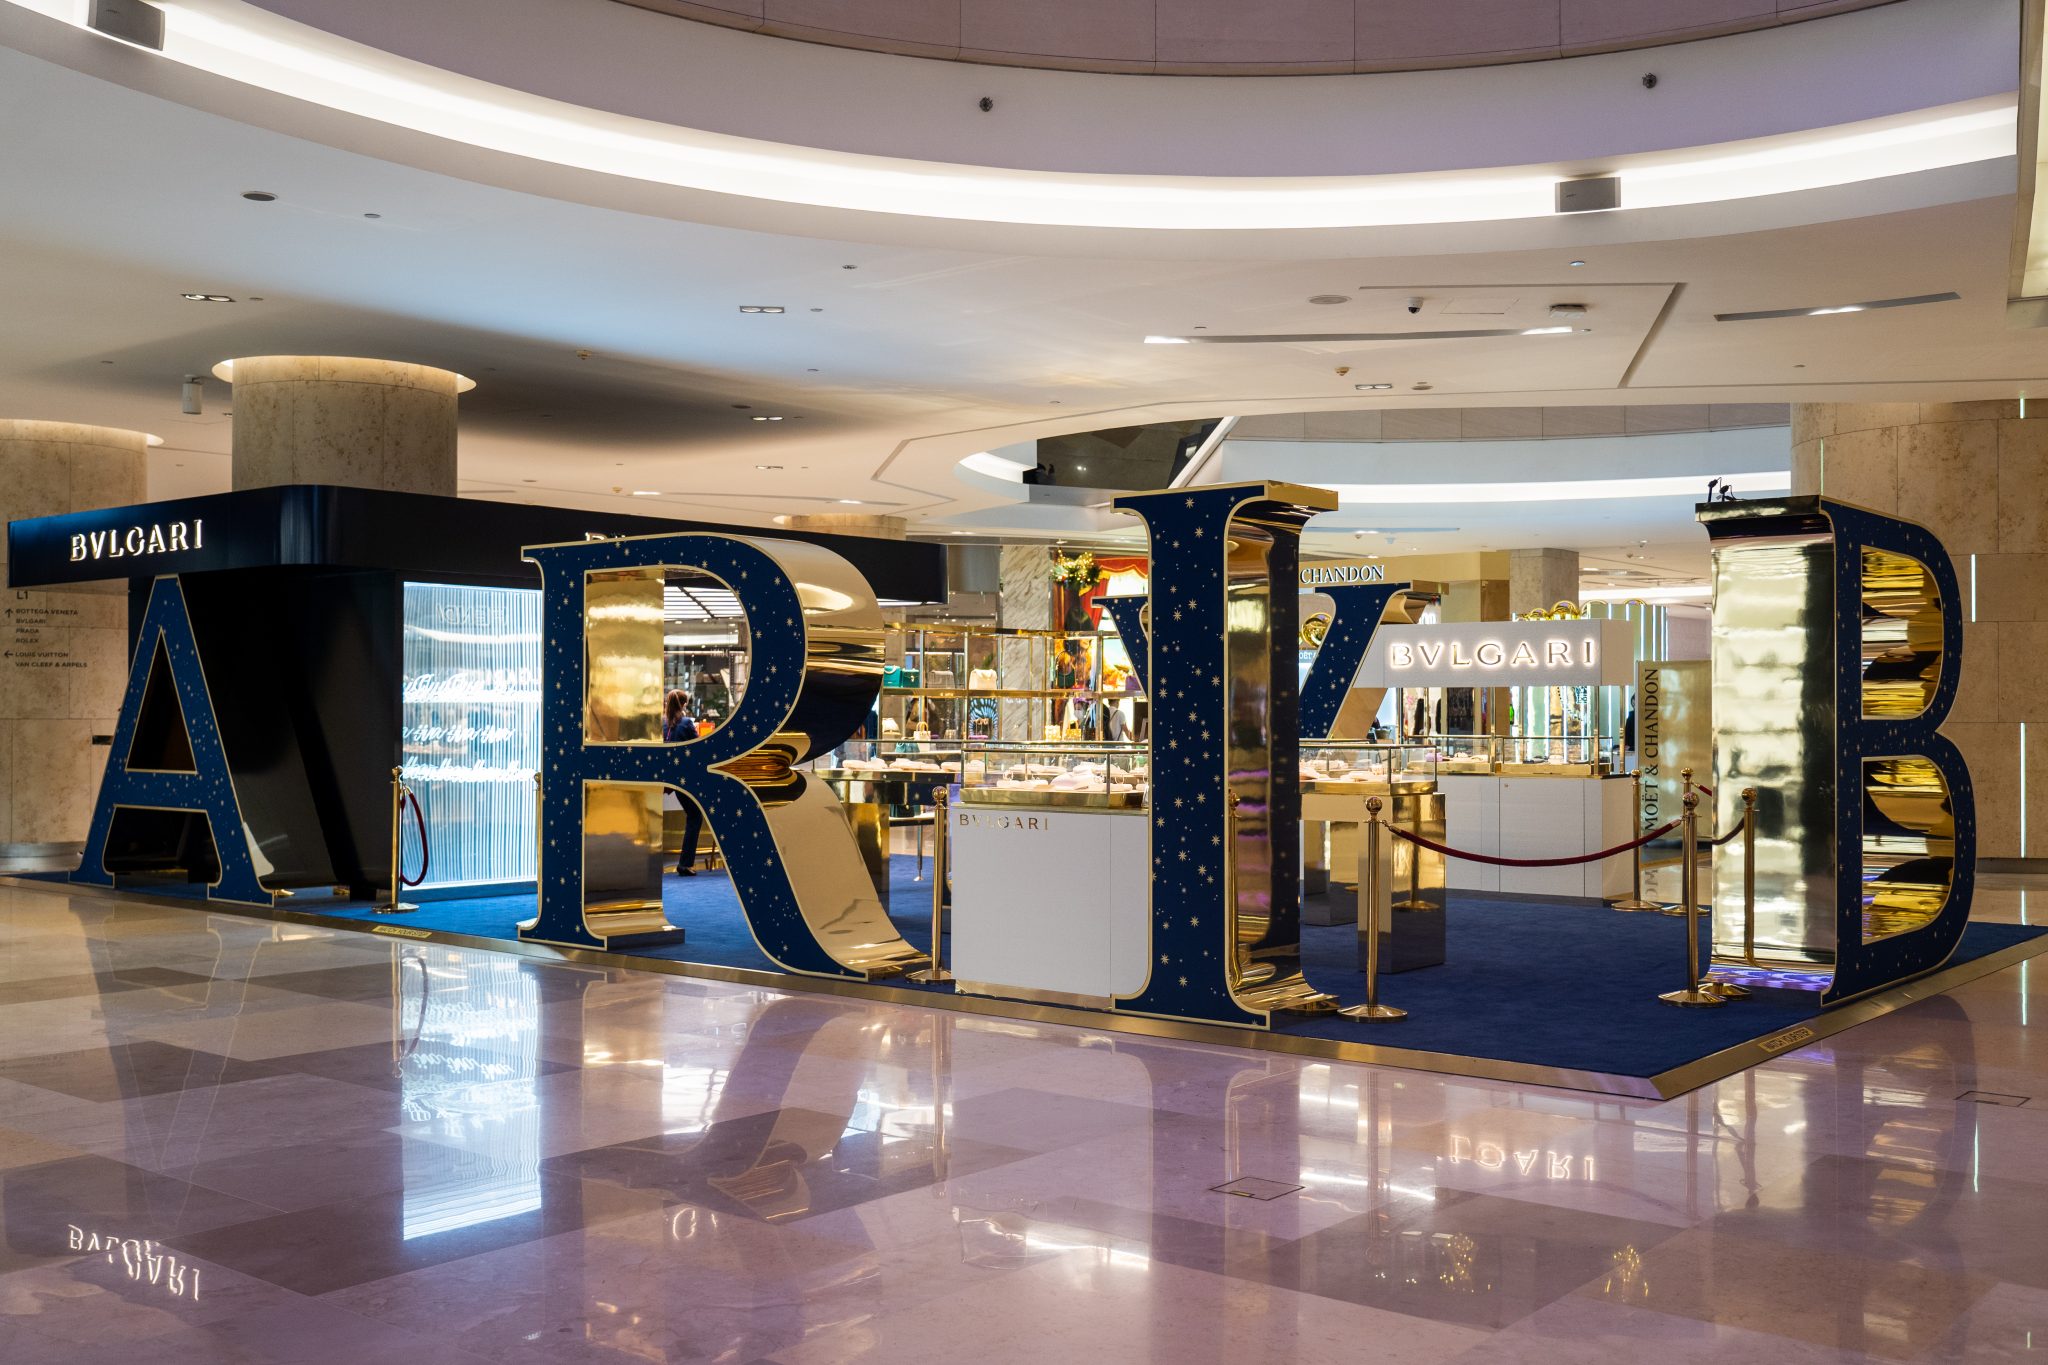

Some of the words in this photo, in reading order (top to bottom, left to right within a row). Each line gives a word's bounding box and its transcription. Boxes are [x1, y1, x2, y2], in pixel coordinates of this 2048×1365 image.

[69, 519, 203, 562] BVLGARI
[1299, 564, 1385, 584] CHANDON
[16, 590, 29, 600] L1
[1391, 638, 1597, 669] BVLGARI
[1644, 668, 1659, 760] CHANDON
[68, 574, 276, 908] A
[519, 531, 870, 983] R
[1644, 763, 1659, 776] &
[959, 813, 1049, 831] BVLGARI
[1641, 780, 1659, 831] MOËT
